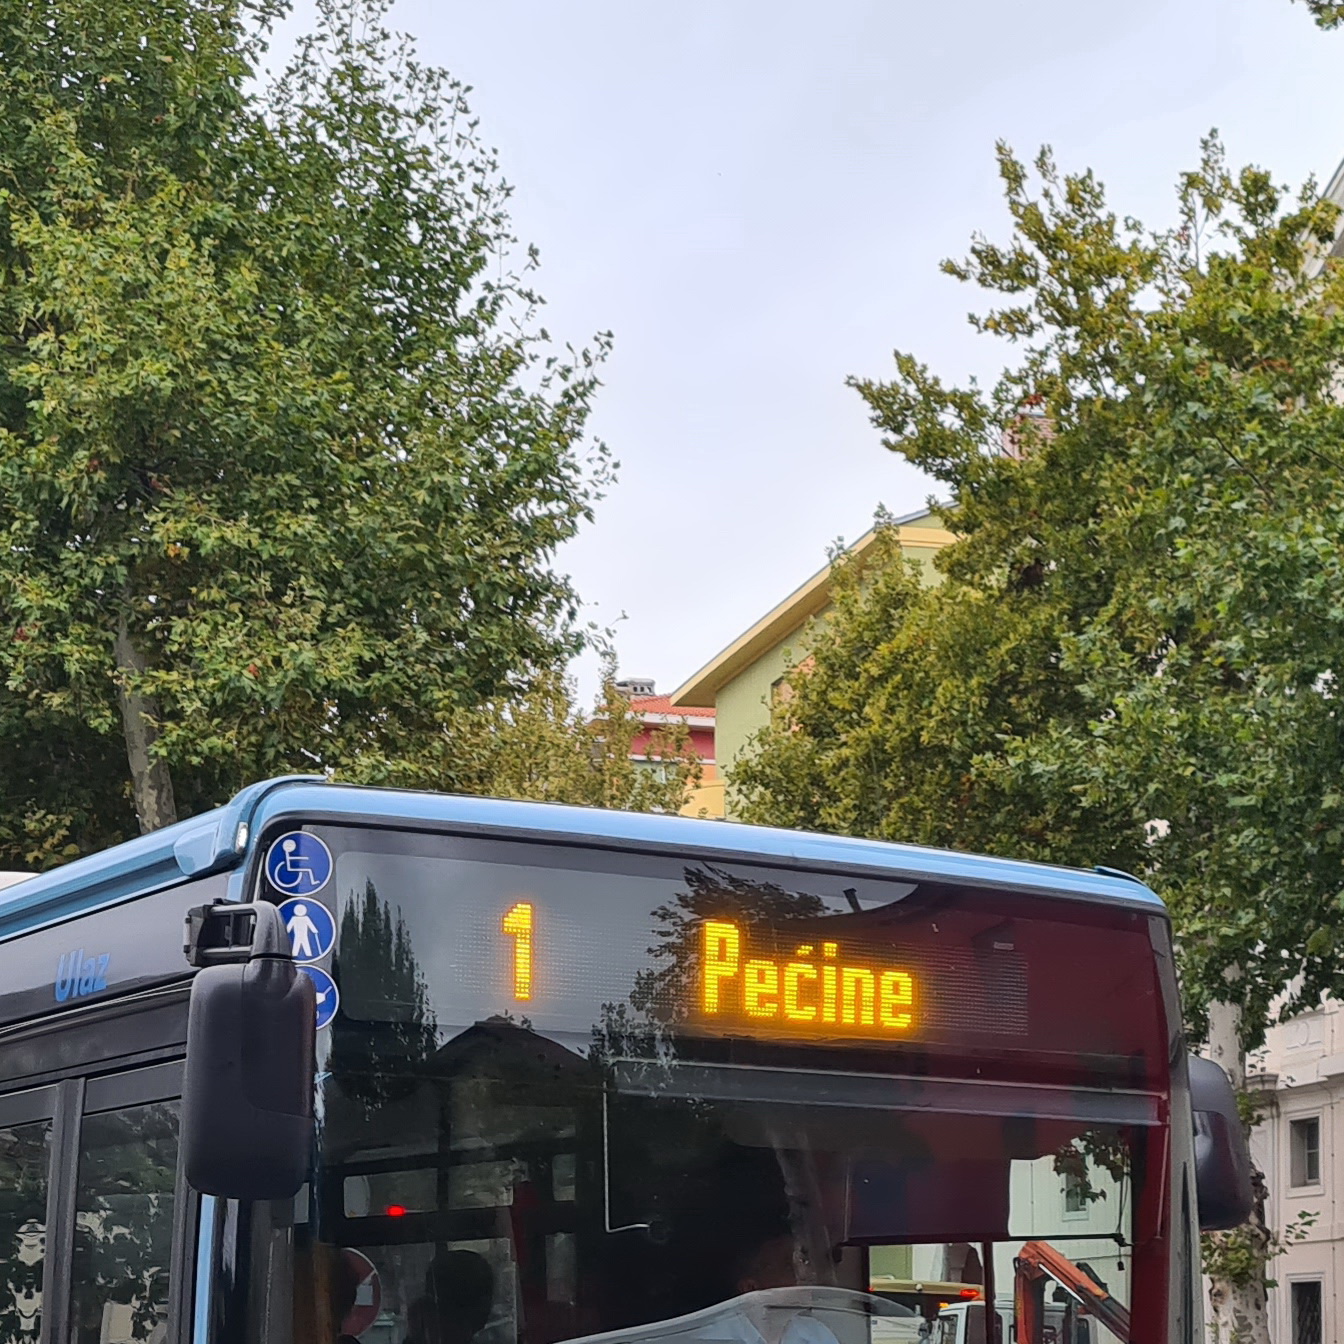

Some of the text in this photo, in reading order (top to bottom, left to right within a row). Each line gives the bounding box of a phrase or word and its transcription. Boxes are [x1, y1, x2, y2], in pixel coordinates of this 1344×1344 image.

[55, 948, 110, 1003] Ulaz
[502, 902, 915, 1029] 1 Pećine
